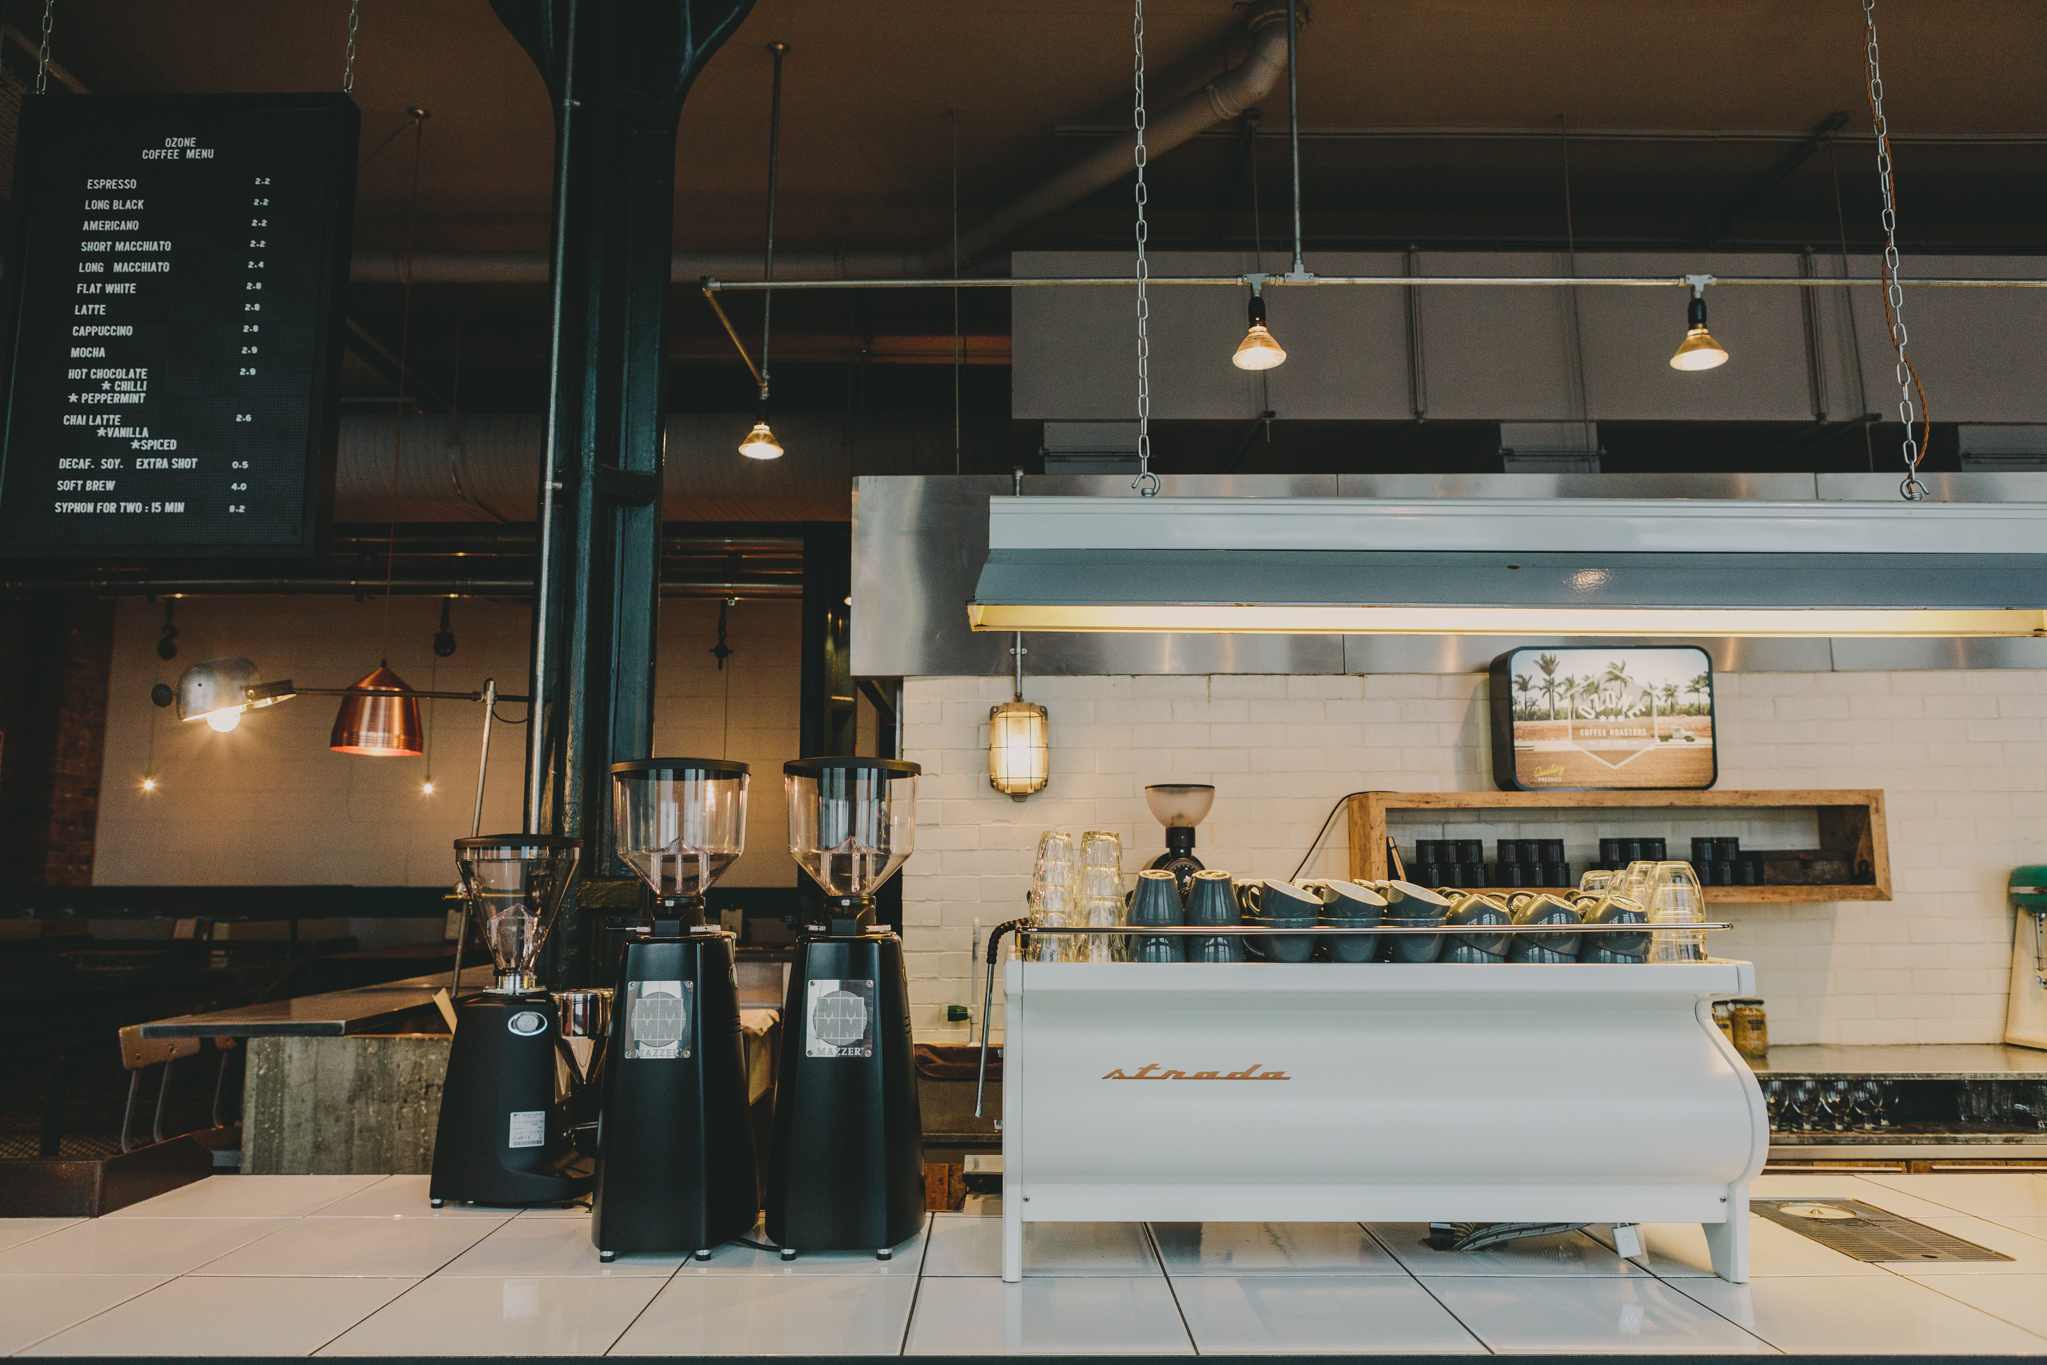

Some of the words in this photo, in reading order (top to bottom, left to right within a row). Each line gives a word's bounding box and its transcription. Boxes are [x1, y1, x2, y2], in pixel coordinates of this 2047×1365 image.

[164, 137, 197, 148] OZONE
[142, 149, 180, 160] COFFEE
[186, 148, 215, 159] MENU
[86, 178, 137, 190] ESPRESSO
[254, 177, 271, 185] 2.2
[84, 199, 111, 211] LONG
[112, 199, 145, 211] BLACK
[253, 198, 269, 206] 2.2
[82, 220, 140, 232] AMERICANO
[251, 219, 268, 227] 2.2
[80, 240, 113, 252] SHORT
[114, 240, 172, 252] MACCHIATO
[249, 239, 266, 248] 2.2
[78, 262, 105, 273] LONG
[112, 261, 170, 273] MACCHIATO
[247, 260, 265, 269] 2.4
[76, 282, 103, 294] FLAT
[104, 282, 137, 294] WHITE
[73, 304, 107, 316] LATTE
[71, 325, 134, 337] CAPPUCCINO
[70, 346, 106, 358] MOCHA
[240, 345, 258, 355] 2.9
[67, 368, 88, 380] HOT
[89, 367, 149, 380] CHOCOLATE
[239, 367, 257, 376] 2.9
[113, 380, 148, 392] CHILLI
[80, 392, 147, 404] PEPPERMINT
[62, 414, 88, 426] CHAI
[88, 414, 122, 426] LATTE
[235, 413, 252, 422] 2.6
[106, 426, 150, 438] VANILLA
[139, 438, 178, 451] SPICED
[135, 457, 170, 470] EXTRA
[170, 457, 199, 469] SHOT
[231, 460, 249, 469] 0.5
[56, 480, 84, 492] SOFT
[85, 479, 116, 492] BREW
[230, 482, 248, 491] 4.0
[54, 502, 95, 514] SYPHON
[96, 501, 118, 514] FOR
[119, 501, 143, 514] TWO
[150, 501, 162, 514] 15
[163, 501, 185, 514] MIN
[1578, 690, 1647, 720] OZONE
[1609, 728, 1647, 736] ROASTERS
[635, 1048, 680, 1058] MAZZER
[816, 1047, 861, 1056] MAZZER
[1101, 1063, 1292, 1080] strada
